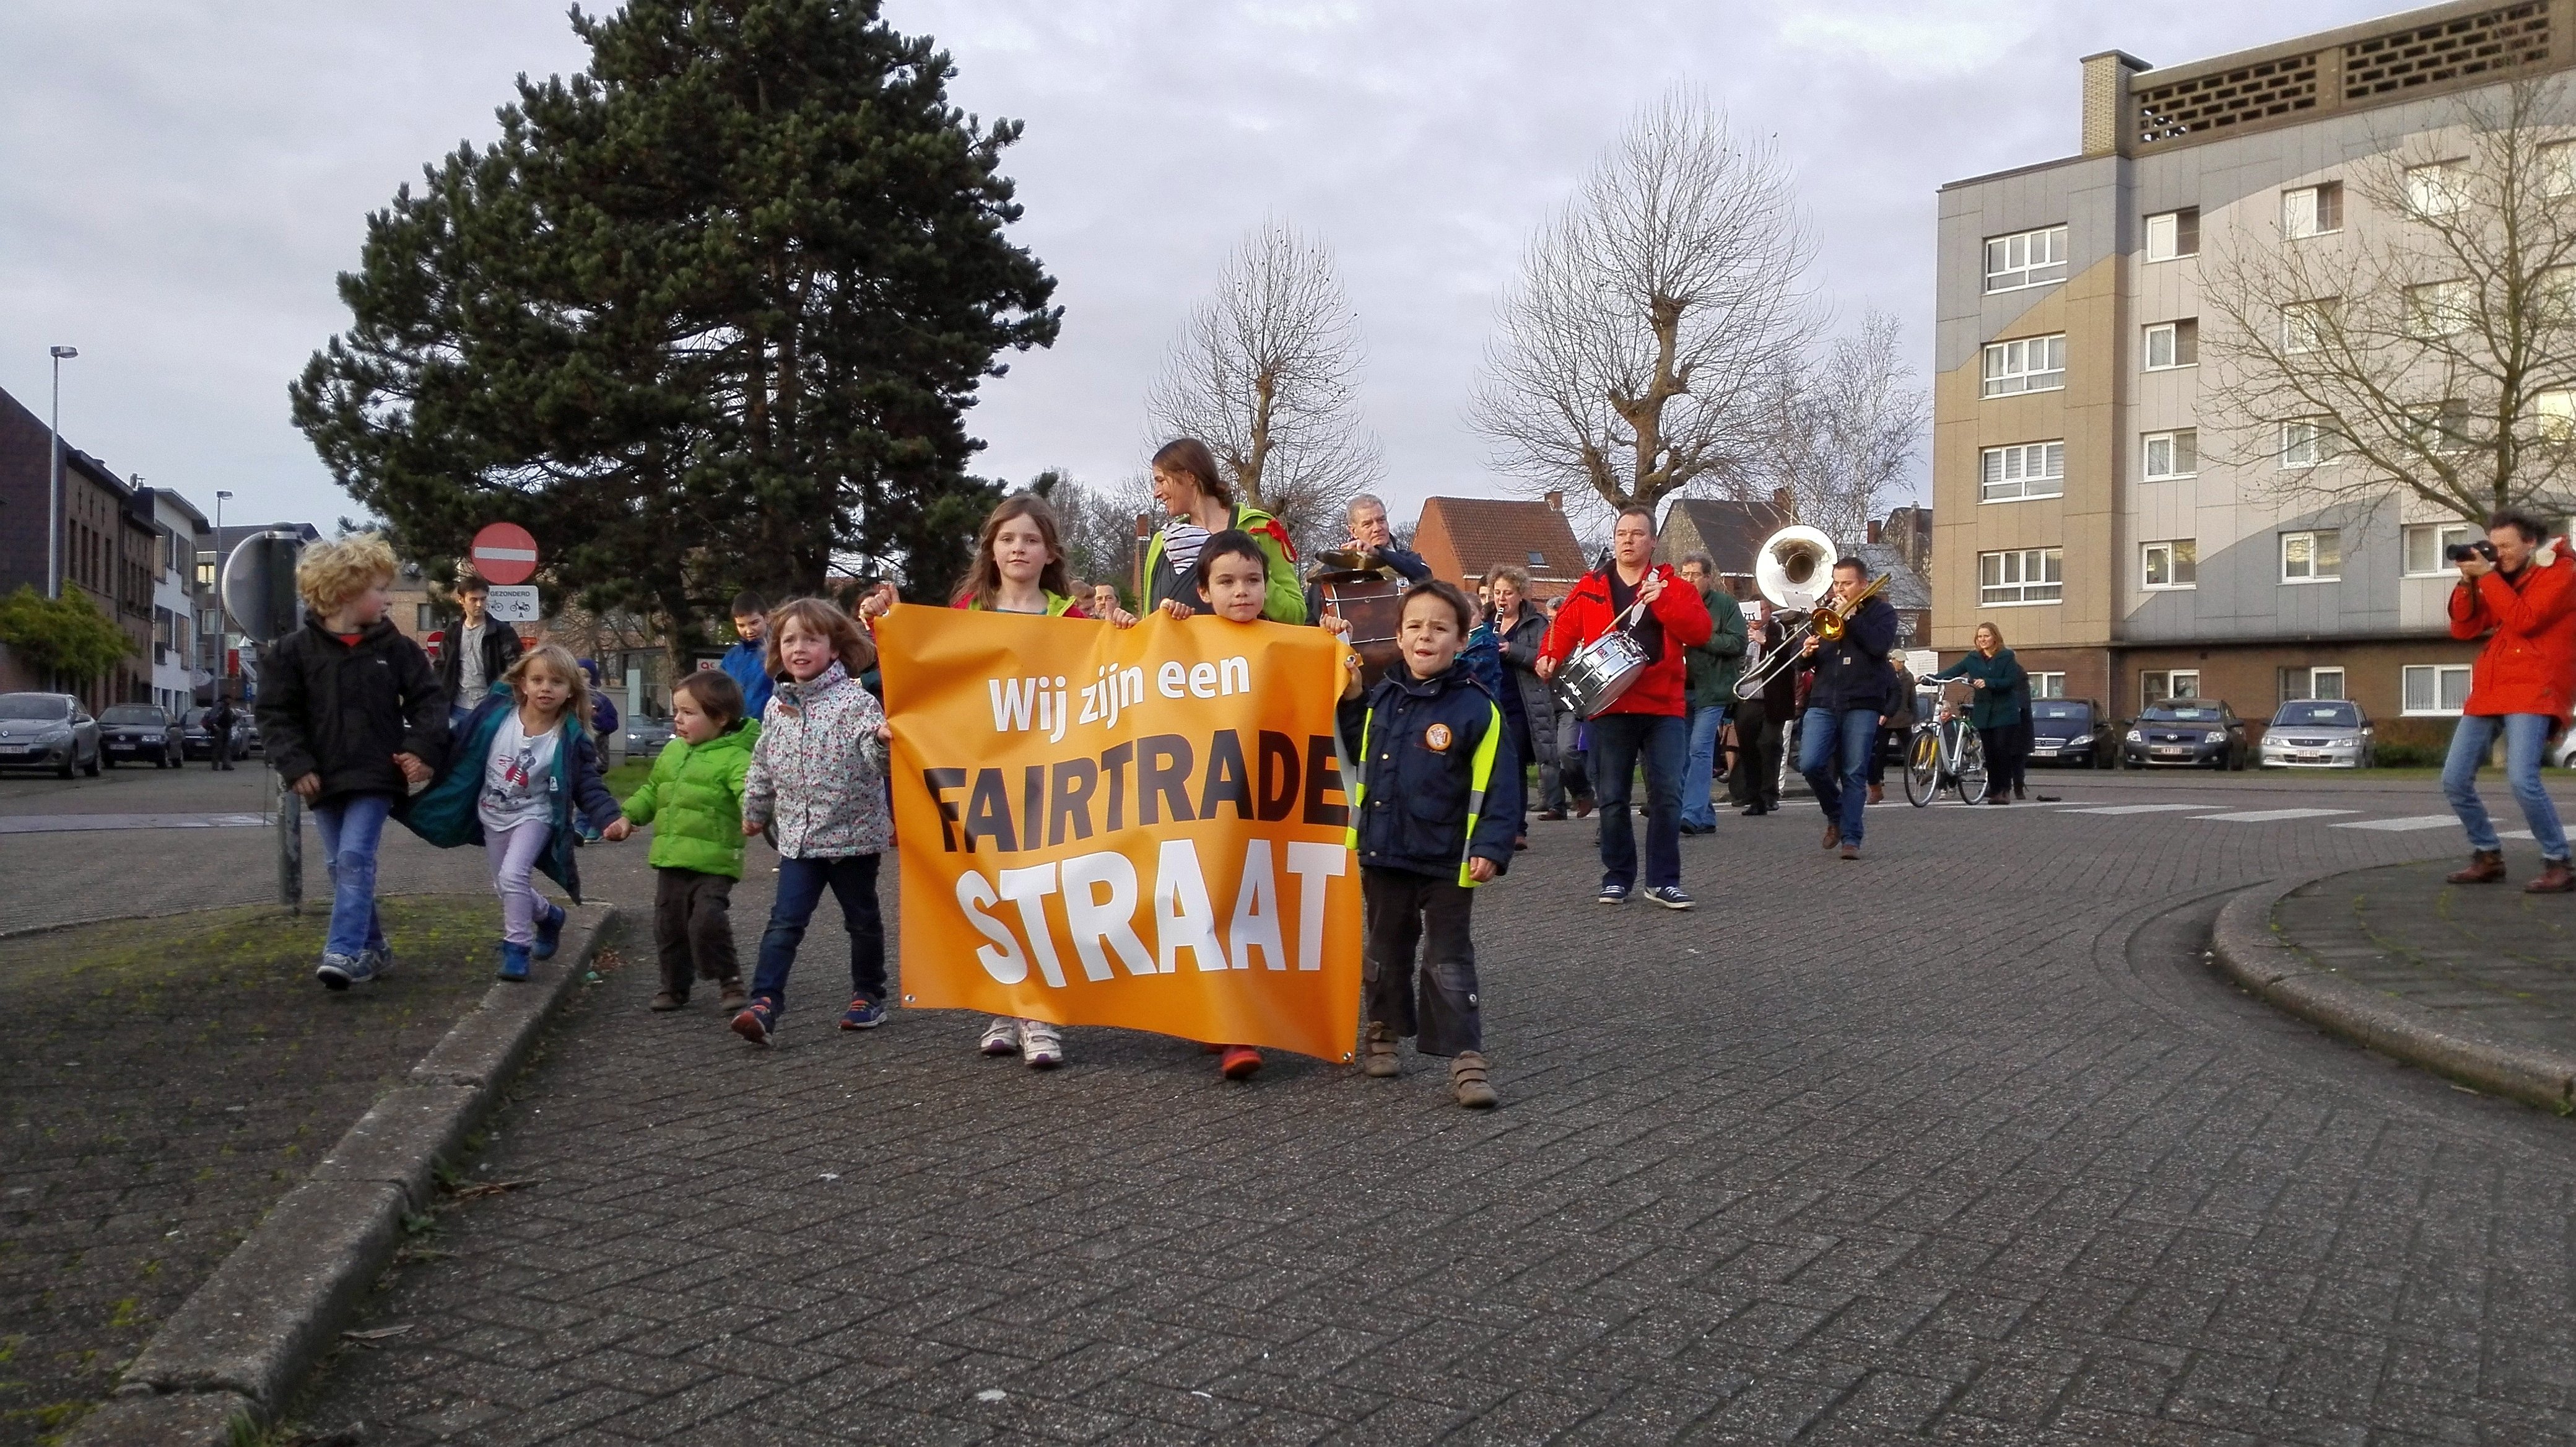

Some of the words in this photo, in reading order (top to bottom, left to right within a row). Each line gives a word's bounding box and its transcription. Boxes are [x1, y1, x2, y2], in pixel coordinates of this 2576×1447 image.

[988, 676, 1066, 743] Wij
[1079, 662, 1144, 729] zijn
[1157, 655, 1250, 698] een
[923, 729, 1349, 854] FAIRTRADE
[955, 839, 1347, 987] STRAAT
